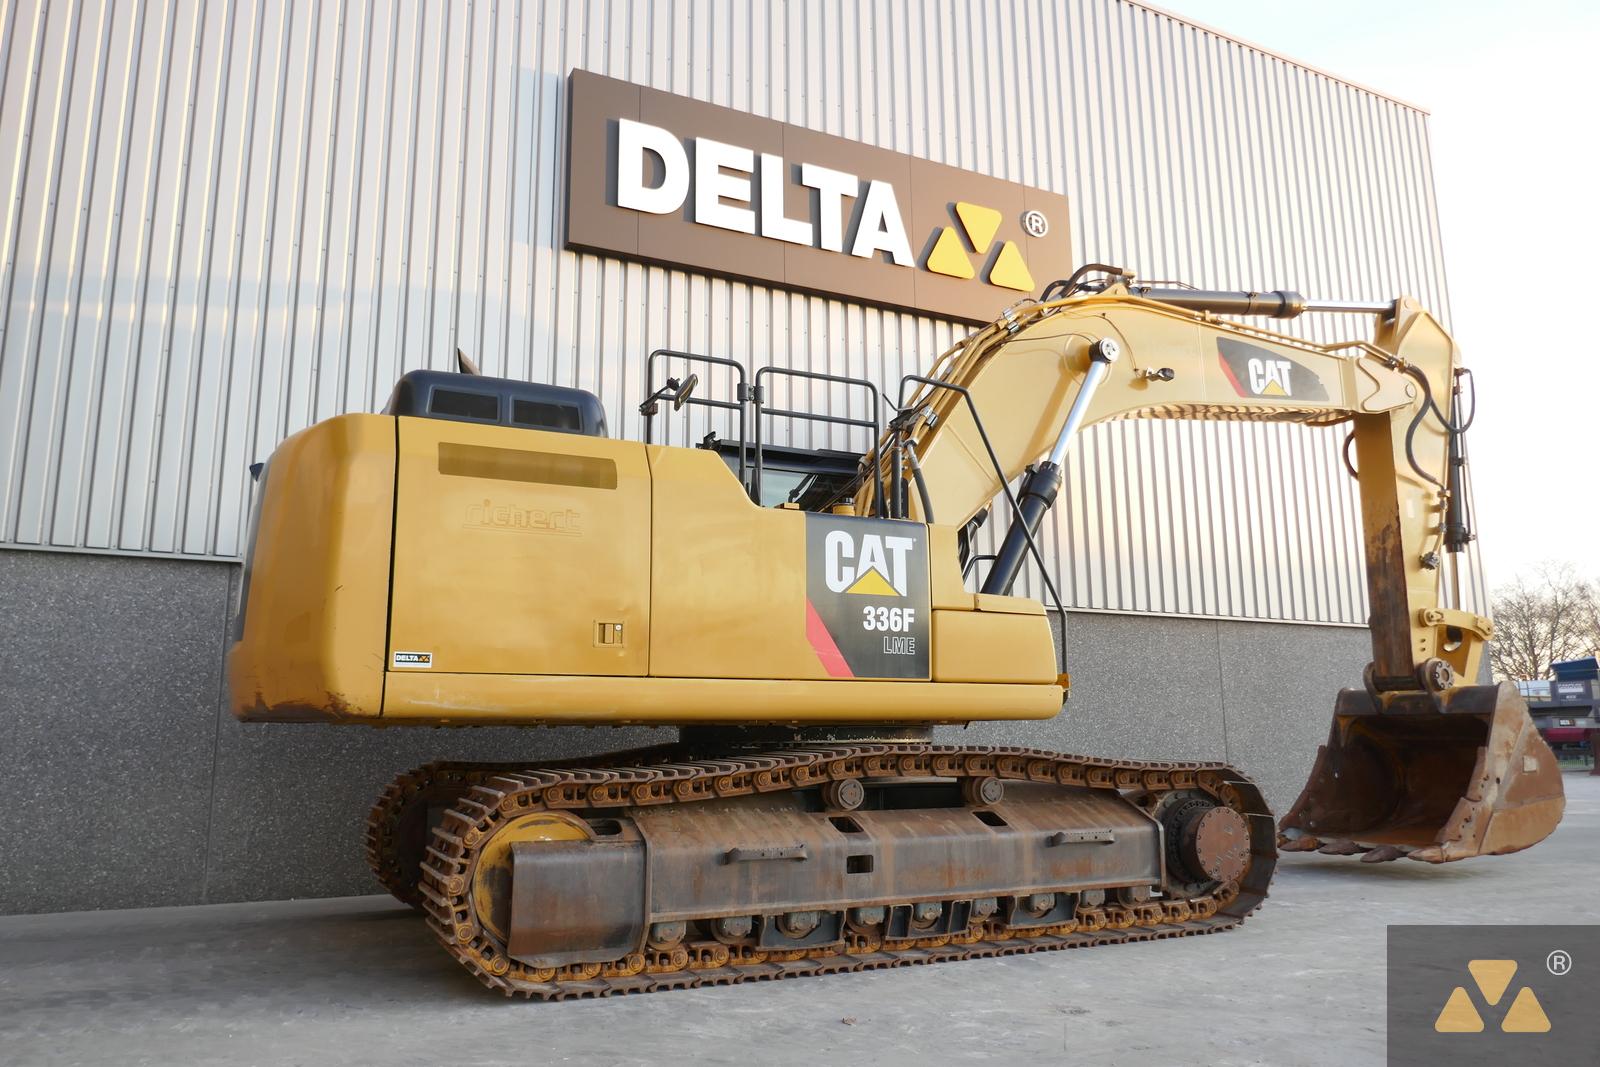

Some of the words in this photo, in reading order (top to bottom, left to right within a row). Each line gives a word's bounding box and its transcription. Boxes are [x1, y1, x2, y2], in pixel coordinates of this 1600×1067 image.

[617, 117, 916, 268] DELTA
[1247, 357, 1293, 397] CAT
[825, 530, 914, 597] CAT
[863, 605, 915, 632] 336F
[396, 654, 419, 662] DELTA
[883, 636, 915, 655] LME
